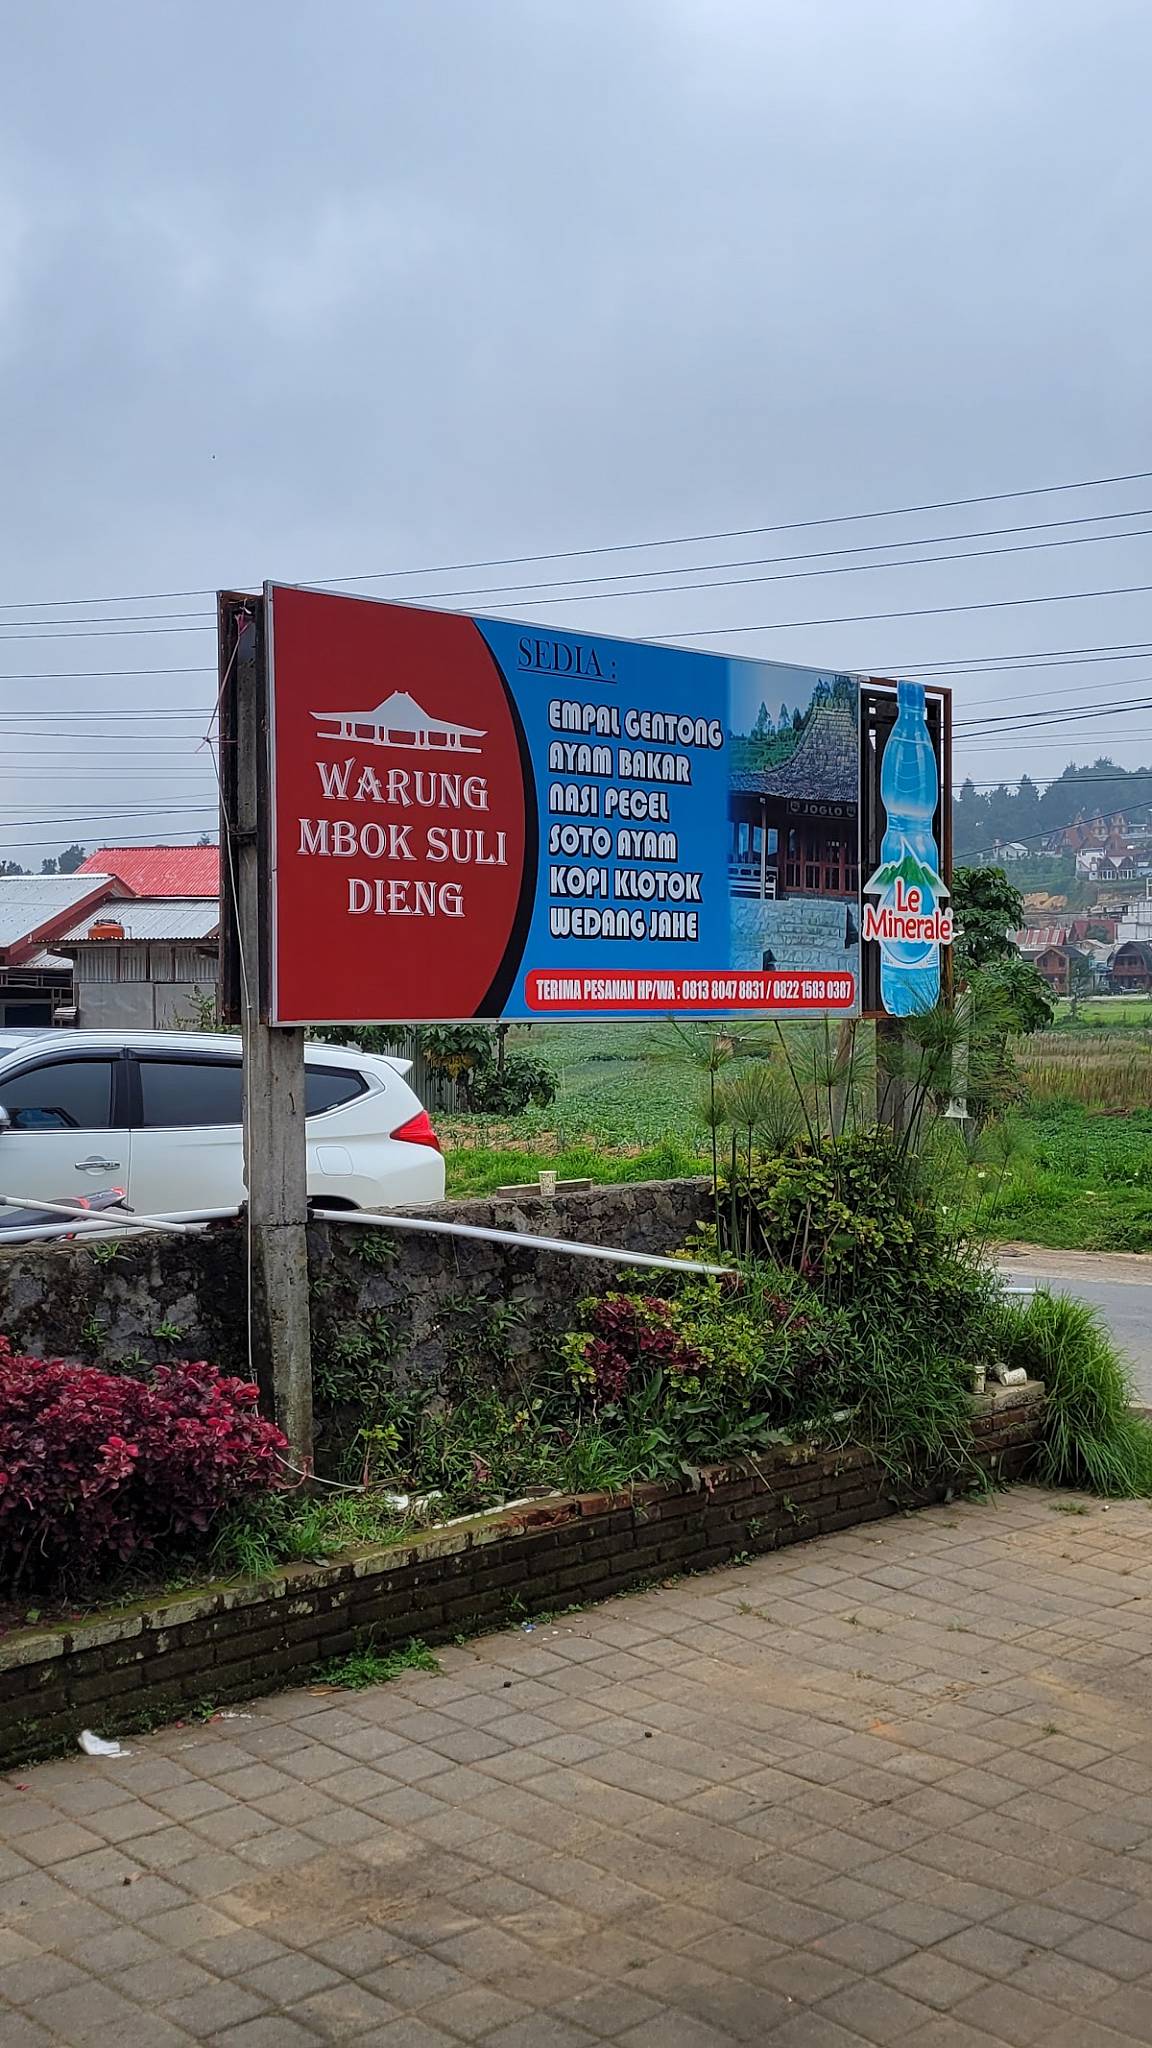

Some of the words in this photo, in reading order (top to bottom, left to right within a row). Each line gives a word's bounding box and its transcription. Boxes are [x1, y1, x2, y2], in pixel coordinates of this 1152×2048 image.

[517, 637, 603, 677] SEDIA
[549, 700, 620, 735] EMPAL
[625, 709, 723, 748] GENTONG
[549, 742, 612, 775] AYAM
[618, 749, 691, 783] BAKAR
[314, 756, 490, 811] WARUNG
[549, 783, 598, 815] NASI
[605, 788, 669, 820] PECEL
[803, 804, 842, 816] JOGLO
[297, 818, 418, 861] MBOK
[426, 827, 509, 866] SULI
[549, 824, 611, 856] SOTO
[617, 829, 677, 861] AYAM
[347, 878, 466, 917] DIENG
[549, 866, 607, 896] KOPI
[614, 869, 701, 901] KLOTOK
[897, 880, 920, 912] Le
[549, 907, 645, 938] WEDANG
[649, 910, 698, 939] JAHE
[865, 908, 951, 940] Minerale
[536, 979, 581, 1000] TERIMA
[584, 979, 634, 1000] PESANAN
[638, 979, 675, 1000] HP/WA
[682, 979, 709, 1000] 0813
[711, 979, 738, 1000] 8047
[738, 980, 764, 1000] 8831
[773, 980, 799, 1000] 0822
[827, 980, 851, 1000] 0387
